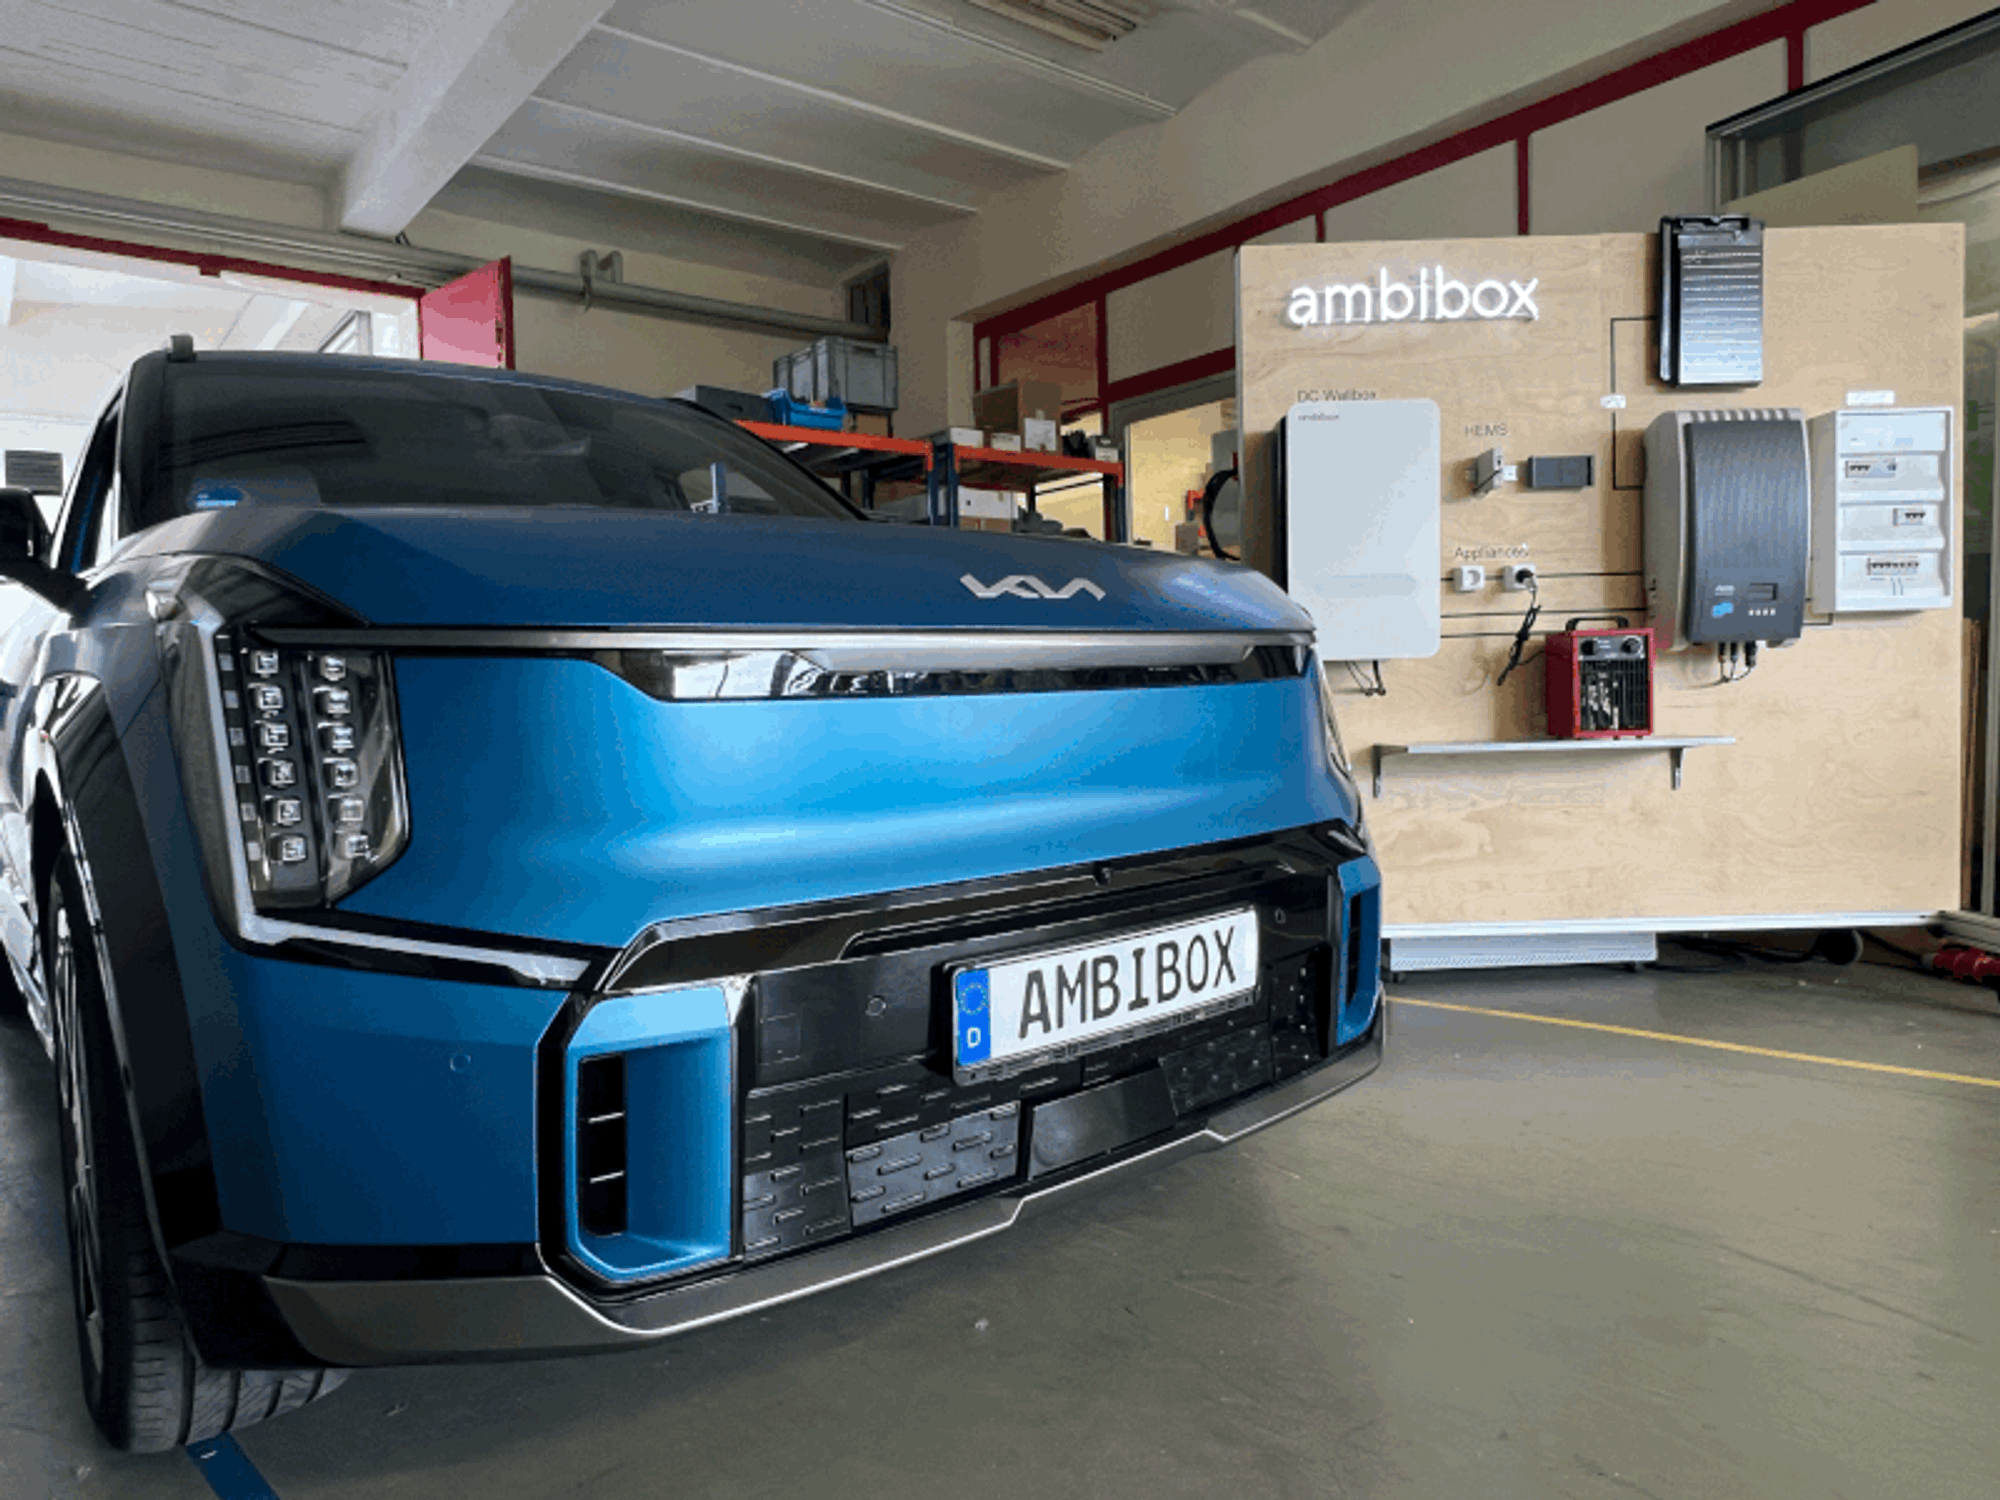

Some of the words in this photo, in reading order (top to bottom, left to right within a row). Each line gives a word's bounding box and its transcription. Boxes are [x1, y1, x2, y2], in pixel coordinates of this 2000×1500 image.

[1288, 264, 1540, 327] ambibox
[1464, 422, 1509, 437] HEMS
[1018, 926, 1236, 1040] AMBIBOX
[967, 1027, 982, 1049] D
